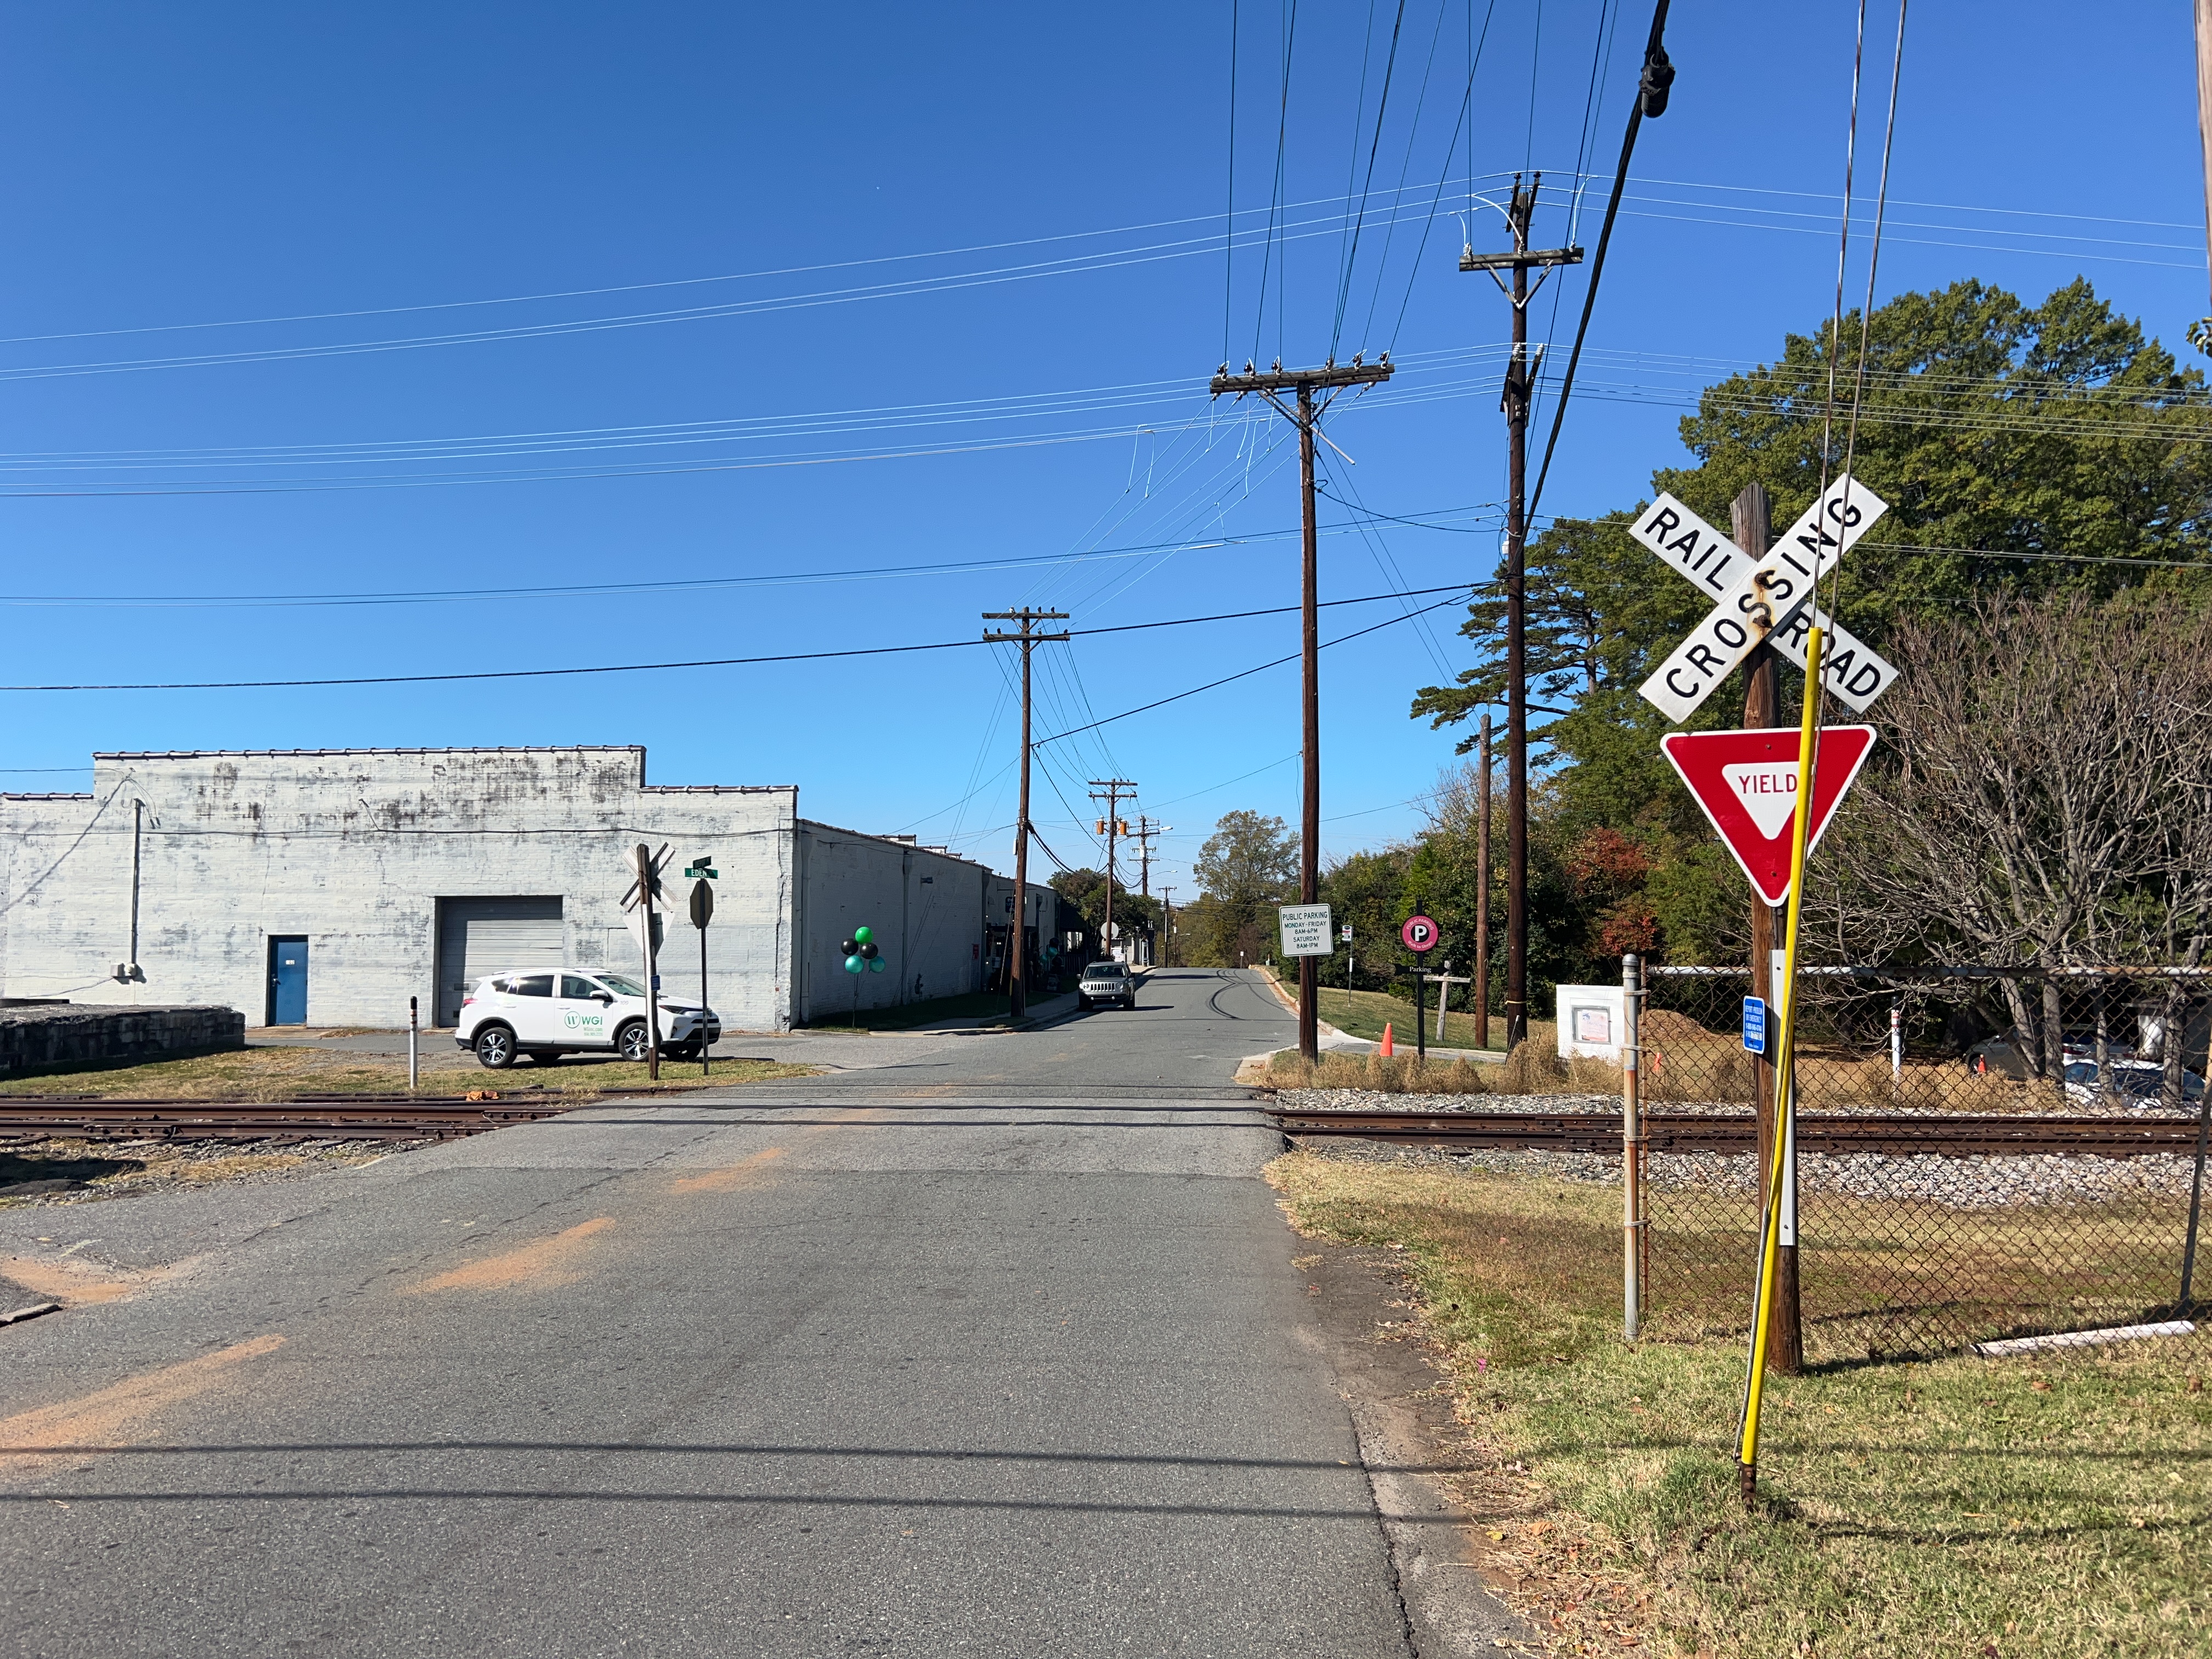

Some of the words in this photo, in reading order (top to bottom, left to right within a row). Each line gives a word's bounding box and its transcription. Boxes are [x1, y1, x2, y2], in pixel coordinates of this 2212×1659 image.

[1644, 506, 1732, 591] RAIL
[1666, 498, 1862, 698] CROSSING
[1738, 774, 1797, 794] YIELD
[1304, 911, 1328, 919] PARKING
[1406, 918, 1418, 930] PUBLIC
[1418, 918, 1434, 930] PARKING
[1415, 925, 1427, 941] P
[582, 1016, 603, 1025] WGI
